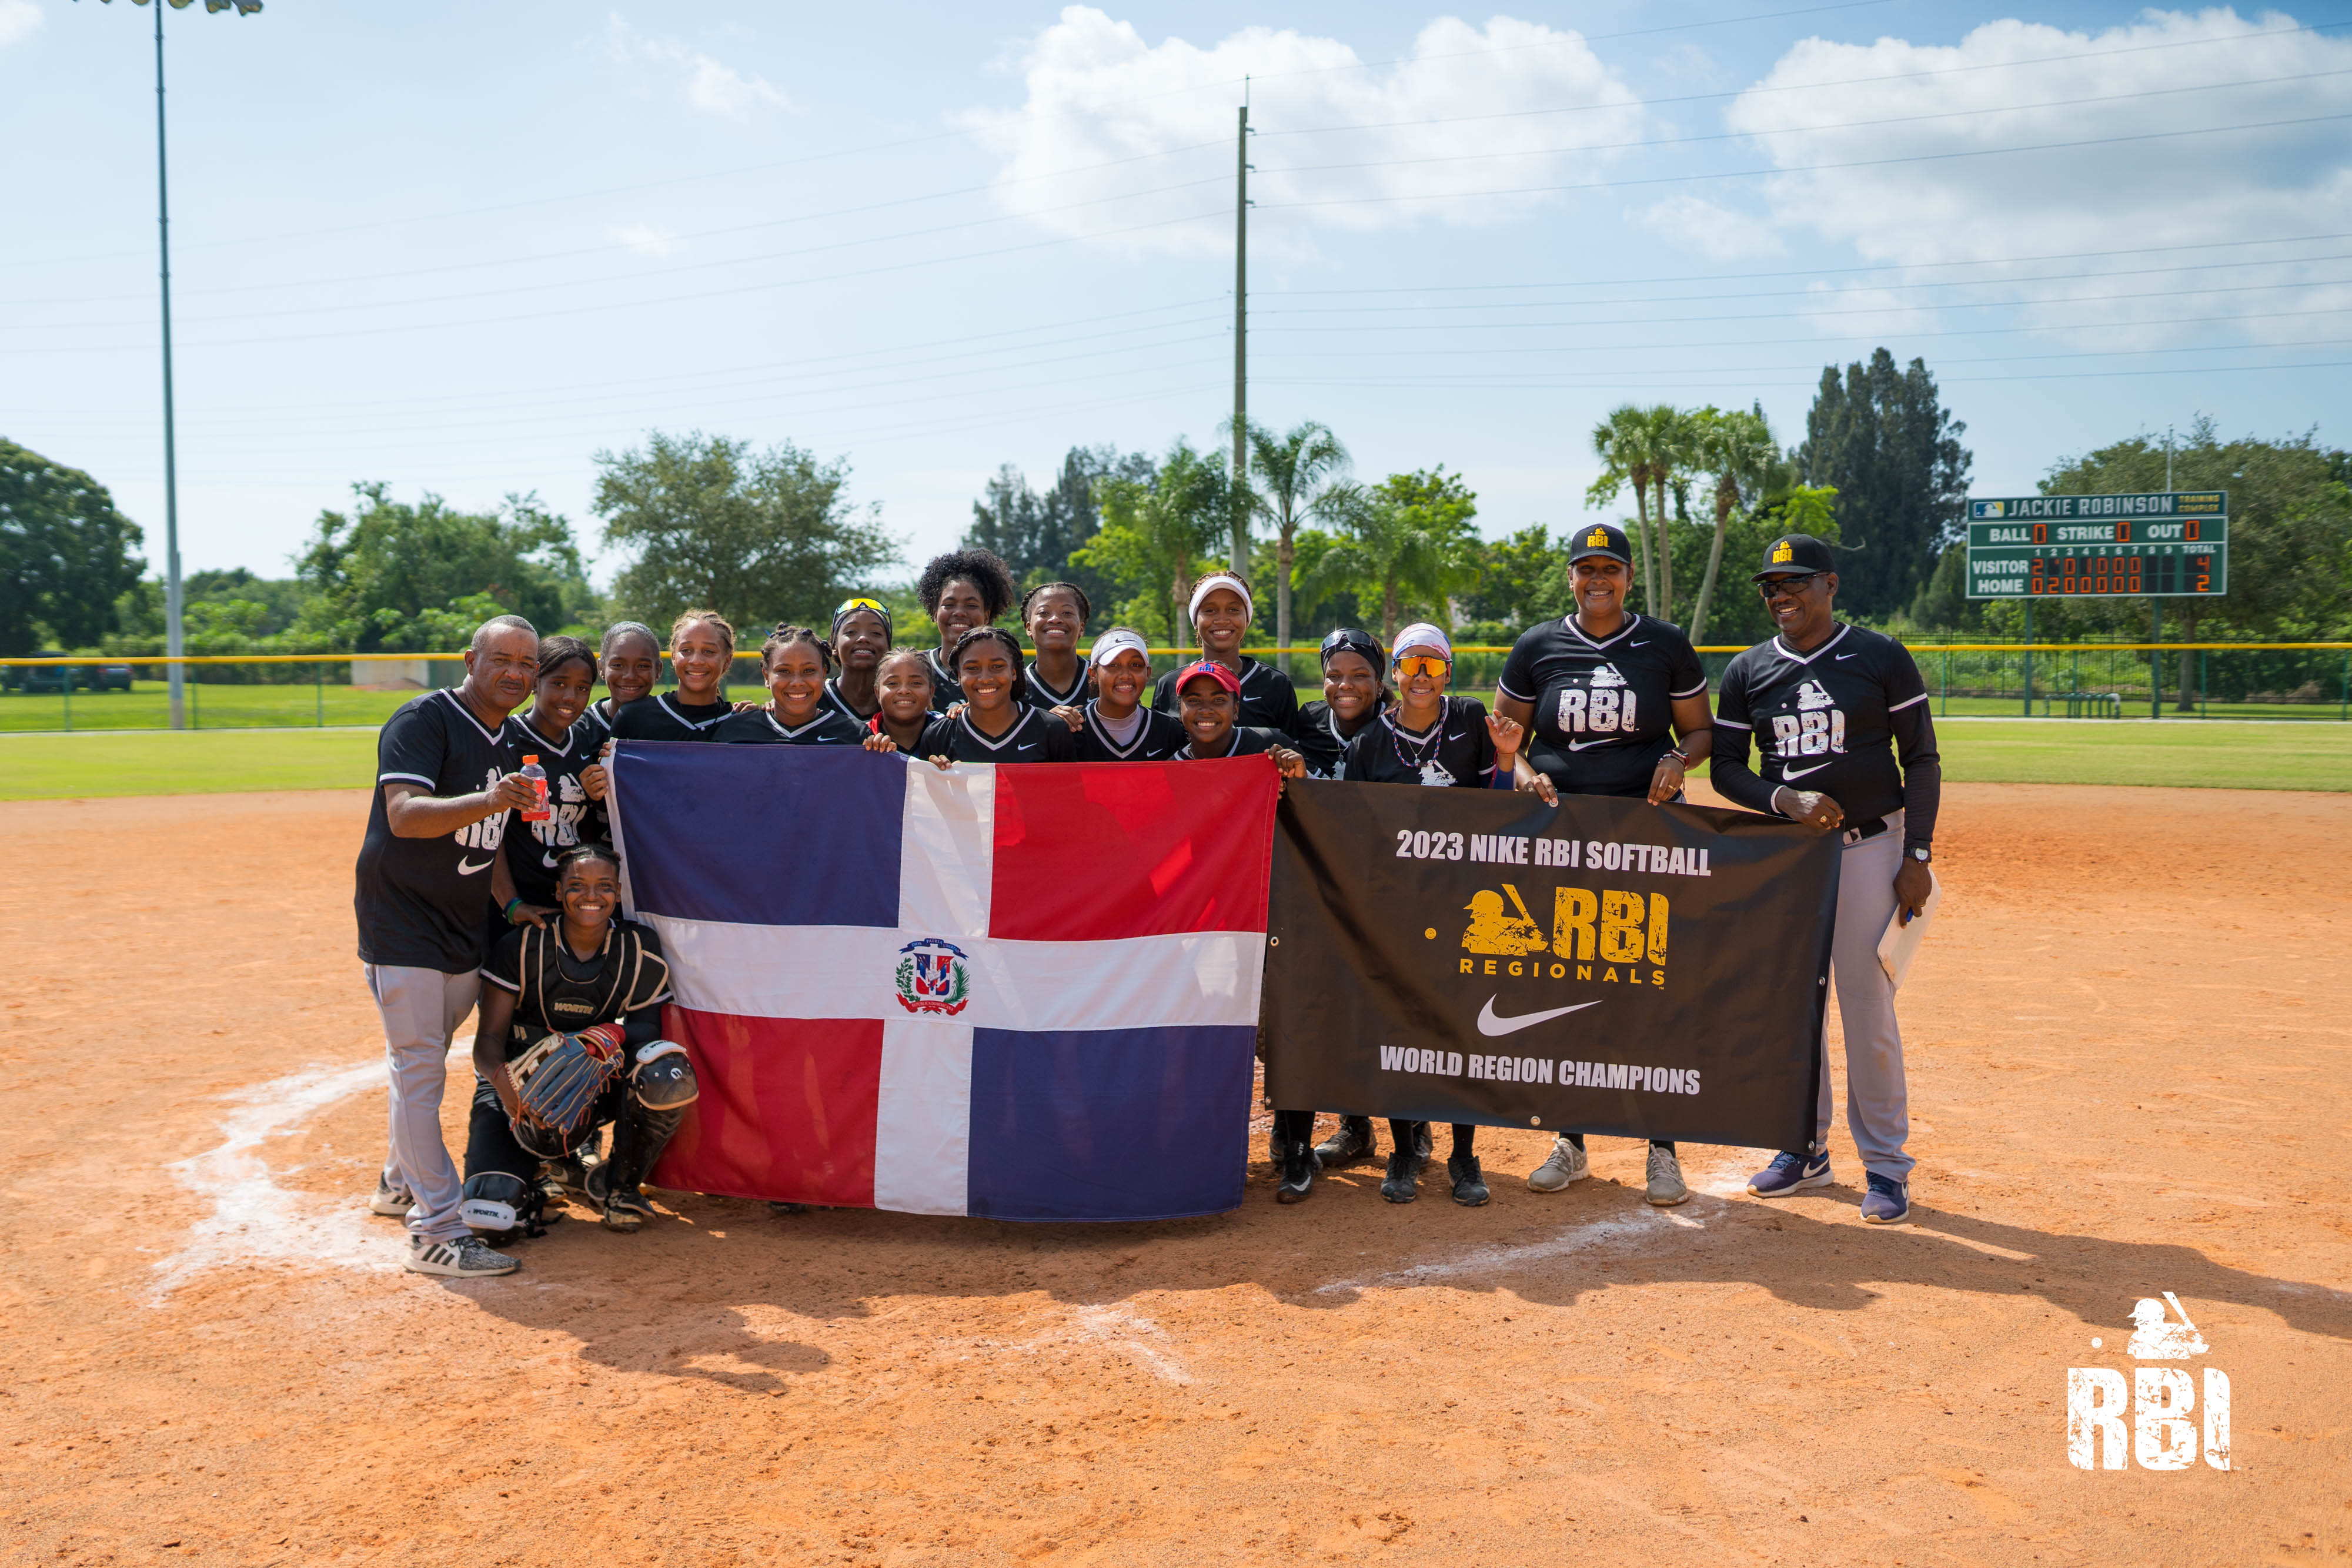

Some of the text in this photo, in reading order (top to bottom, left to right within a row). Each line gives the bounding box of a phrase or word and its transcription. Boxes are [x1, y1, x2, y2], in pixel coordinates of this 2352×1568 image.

[2008, 496, 2173, 516] JACKIE ROBINSON
[2178, 504, 2219, 513] COMPLEX
[1587, 535, 1608, 547] RBI
[1989, 520, 2200, 544] BALL 0 STRIKE 0 OUT 0
[1772, 549, 1792, 564] RBI
[2050, 548, 2057, 556] 2
[2066, 547, 2073, 556] 3
[2099, 547, 2106, 555] 5
[2164, 546, 2172, 554] 9
[2181, 545, 2216, 554] TOTAL
[1972, 560, 2029, 574] VISITOR
[1977, 575, 2210, 593] HOME 0 2 0 0 0 0 0 2
[1558, 689, 1636, 732] RBI
[1772, 709, 1845, 756] RBI
[1396, 830, 1711, 877] 2023 NIKE RBI SOFTBALL
[1552, 887, 1669, 966] RBI
[1459, 958, 1665, 985] REGIONALS
[1380, 1045, 1700, 1095] WORLD REGION CHAMPIONS
